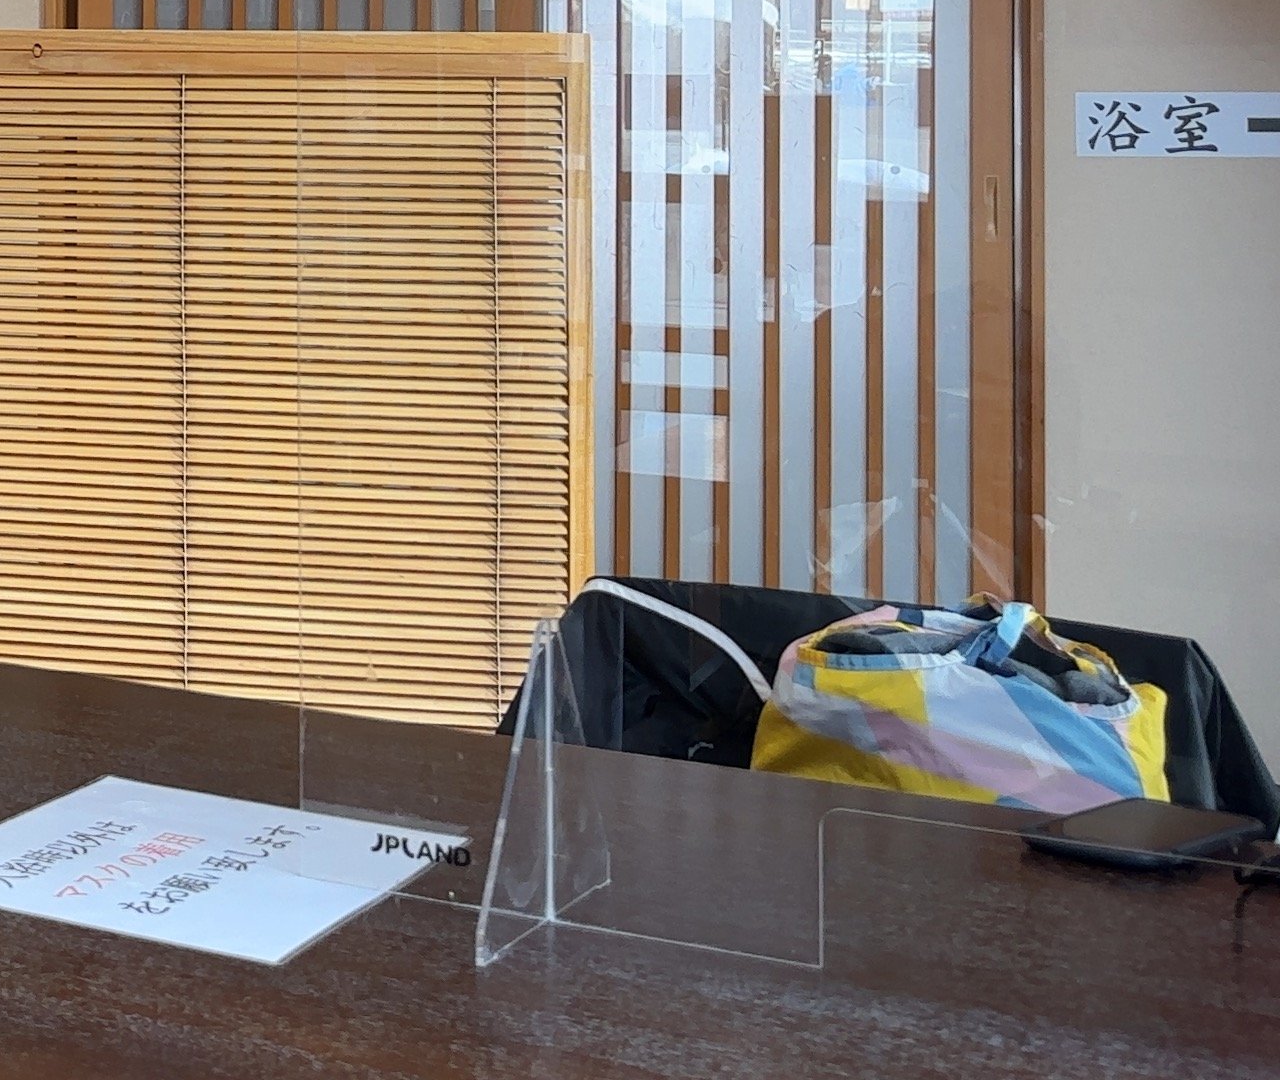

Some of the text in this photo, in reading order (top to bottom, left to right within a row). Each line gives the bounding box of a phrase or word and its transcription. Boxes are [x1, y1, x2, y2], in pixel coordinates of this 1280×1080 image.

[1088, 95, 1221, 153] 浴室
[53, 831, 207, 898] マスクの着用
[370, 832, 472, 867] JPLAND
